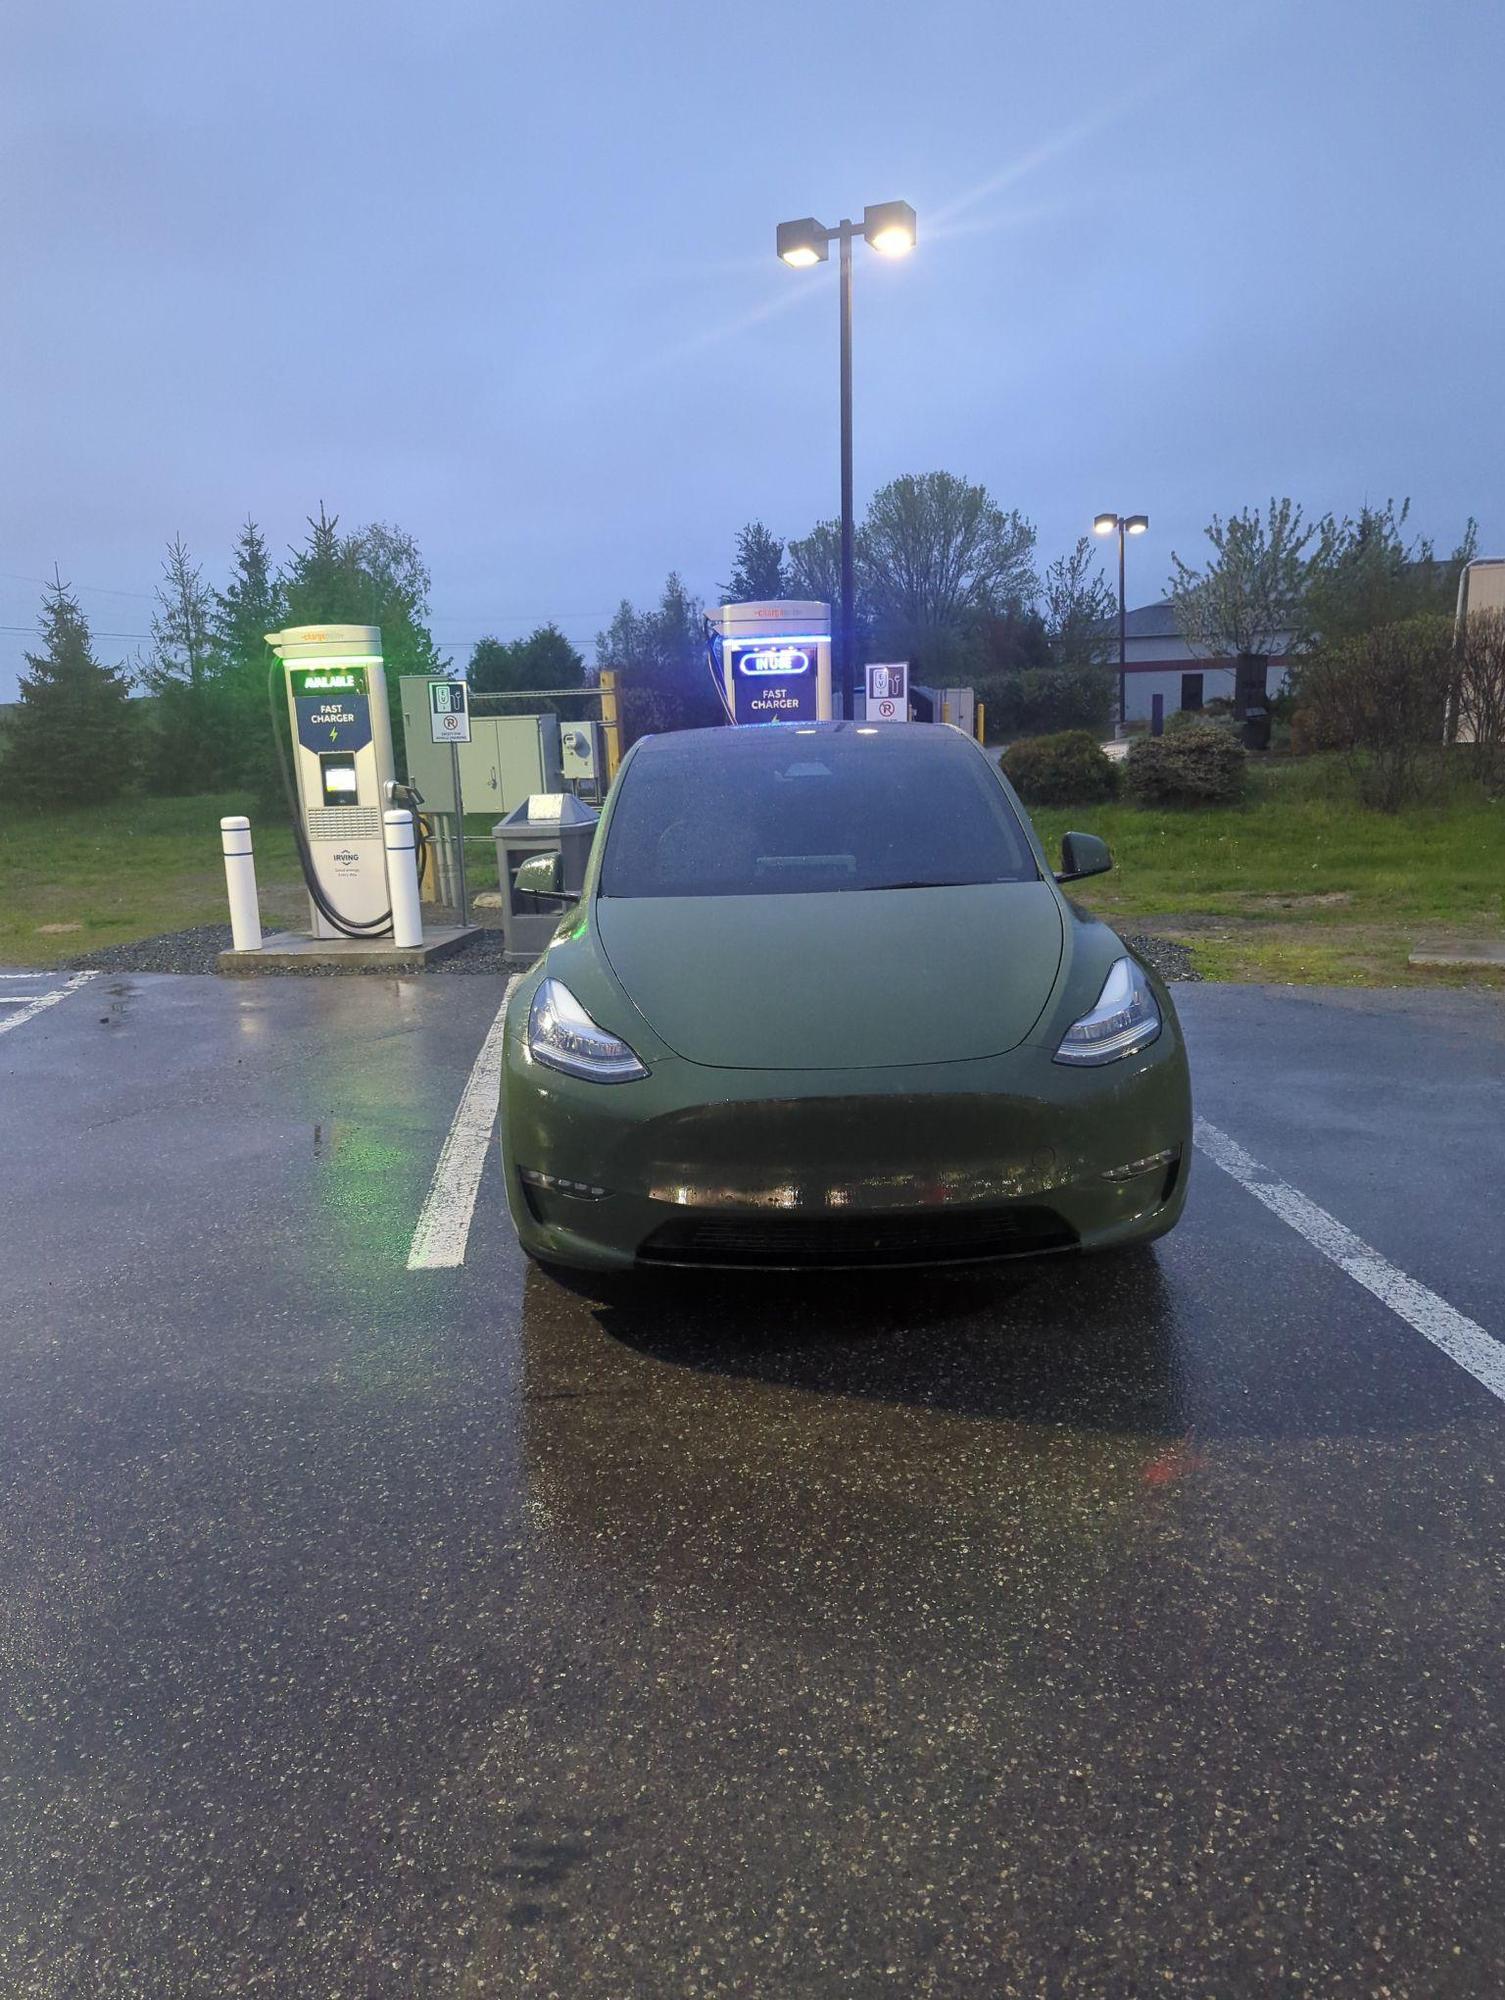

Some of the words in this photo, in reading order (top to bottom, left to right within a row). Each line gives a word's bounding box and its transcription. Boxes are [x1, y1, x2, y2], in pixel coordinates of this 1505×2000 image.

[763, 689, 788, 699] FAST
[320, 704, 342, 714] FAST
[751, 699, 800, 710] CHARGER
[311, 713, 355, 723] CHARGER
